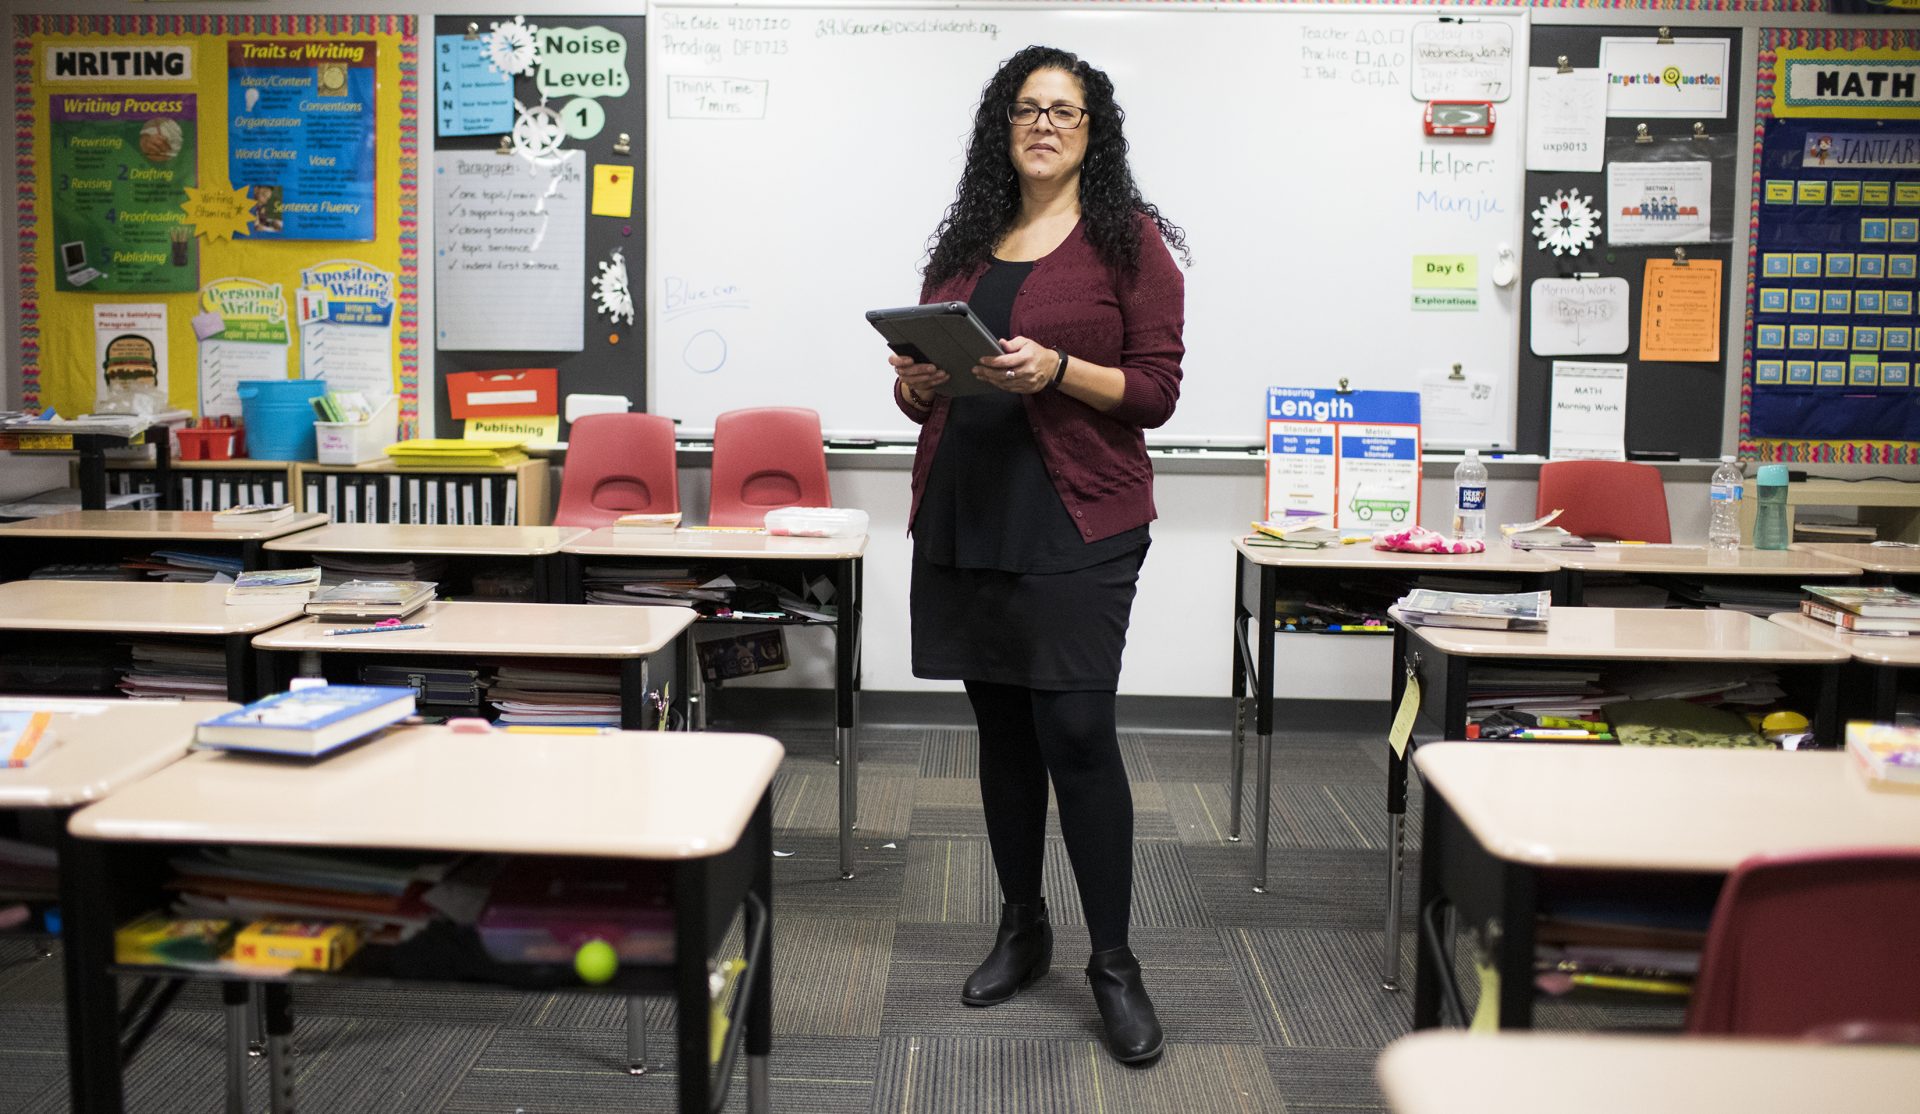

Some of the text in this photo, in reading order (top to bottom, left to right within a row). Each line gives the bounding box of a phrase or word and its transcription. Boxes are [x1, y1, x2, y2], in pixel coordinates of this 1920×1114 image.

[662, 12, 689, 30] Site
[690, 15, 720, 30] Code
[1300, 25, 1350, 41] Teacher
[546, 35, 620, 54] Noise
[242, 43, 365, 62] Traits of Writing
[1301, 46, 1349, 62] Practice
[1418, 47, 1474, 62] Wednesday
[56, 51, 184, 77] WRITING
[241, 75, 312, 88] Ideas/Content
[545, 68, 622, 87] Level:
[1608, 72, 1641, 87] Target
[1643, 72, 1660, 85] the
[1816, 71, 1916, 98] MATH
[673, 80, 753, 95] Think Time
[1480, 82, 1502, 94] 77
[64, 98, 183, 116] Writing Process
[299, 100, 363, 112] Conventions
[708, 99, 742, 114] mins
[235, 116, 301, 128] Organization
[576, 108, 588, 127] 1
[71, 137, 123, 149] Prewriting
[1543, 142, 1588, 153] uxp9013
[235, 148, 297, 160] Word Choice
[309, 155, 336, 167] Voice
[117, 164, 174, 182] 2 Drafting
[1418, 150, 1495, 181] Helper:
[71, 178, 112, 190] Revising
[459, 191, 477, 200] one
[273, 201, 361, 216] Sentence Fluency
[1416, 190, 1504, 221] Manju
[105, 208, 187, 224] 4 Proofreading
[494, 227, 536, 235] sentence
[1901, 226, 1909, 235] 2
[113, 251, 167, 265] Publishing
[1426, 262, 1465, 275] Day 6
[303, 266, 391, 287] Expository
[208, 286, 280, 302] Personal
[330, 284, 389, 305] Writing
[1542, 283, 1617, 298] Morning Work
[1414, 296, 1477, 306] Explorations
[1768, 295, 1904, 308] 12 13 14 15 16
[220, 302, 279, 322] Writing
[1558, 301, 1585, 320] Page
[1766, 333, 1777, 342] 19
[1797, 333, 1811, 342] 20
[1859, 334, 1873, 343] 22
[1890, 334, 1905, 343] 23
[1794, 368, 1807, 377] 27
[1858, 369, 1872, 378] 29
[1888, 369, 1902, 379] 30
[1270, 386, 1315, 399] Measuring
[1574, 387, 1603, 395] MATH
[1270, 396, 1354, 422] Length
[1557, 402, 1619, 412] Morning Work
[475, 422, 544, 437] Publishing
[1283, 425, 1322, 433] Standard
[1365, 428, 1391, 436] Metric
